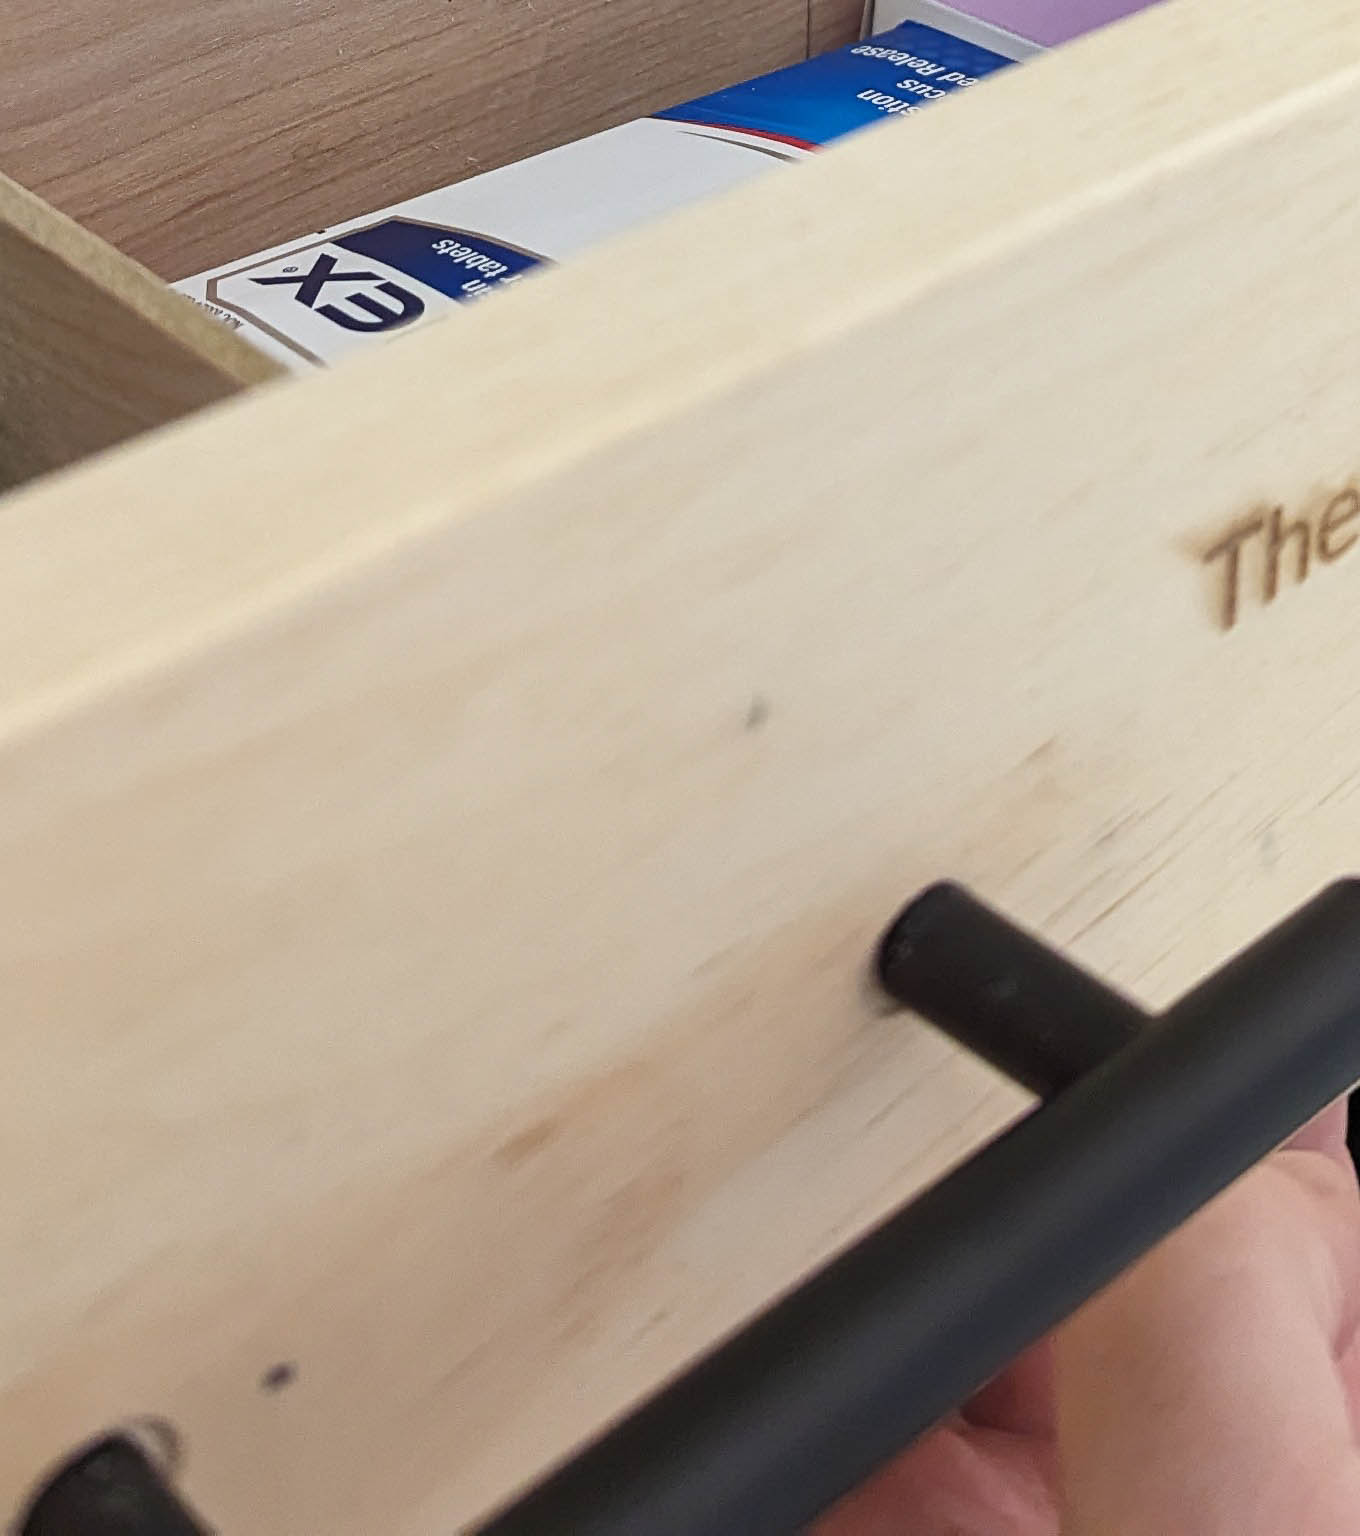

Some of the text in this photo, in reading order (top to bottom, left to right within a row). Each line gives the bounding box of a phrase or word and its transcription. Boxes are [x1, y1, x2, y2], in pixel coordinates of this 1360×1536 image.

[851, 44, 948, 79] Release
[431, 239, 508, 279] tablets
[249, 252, 425, 332] EX
